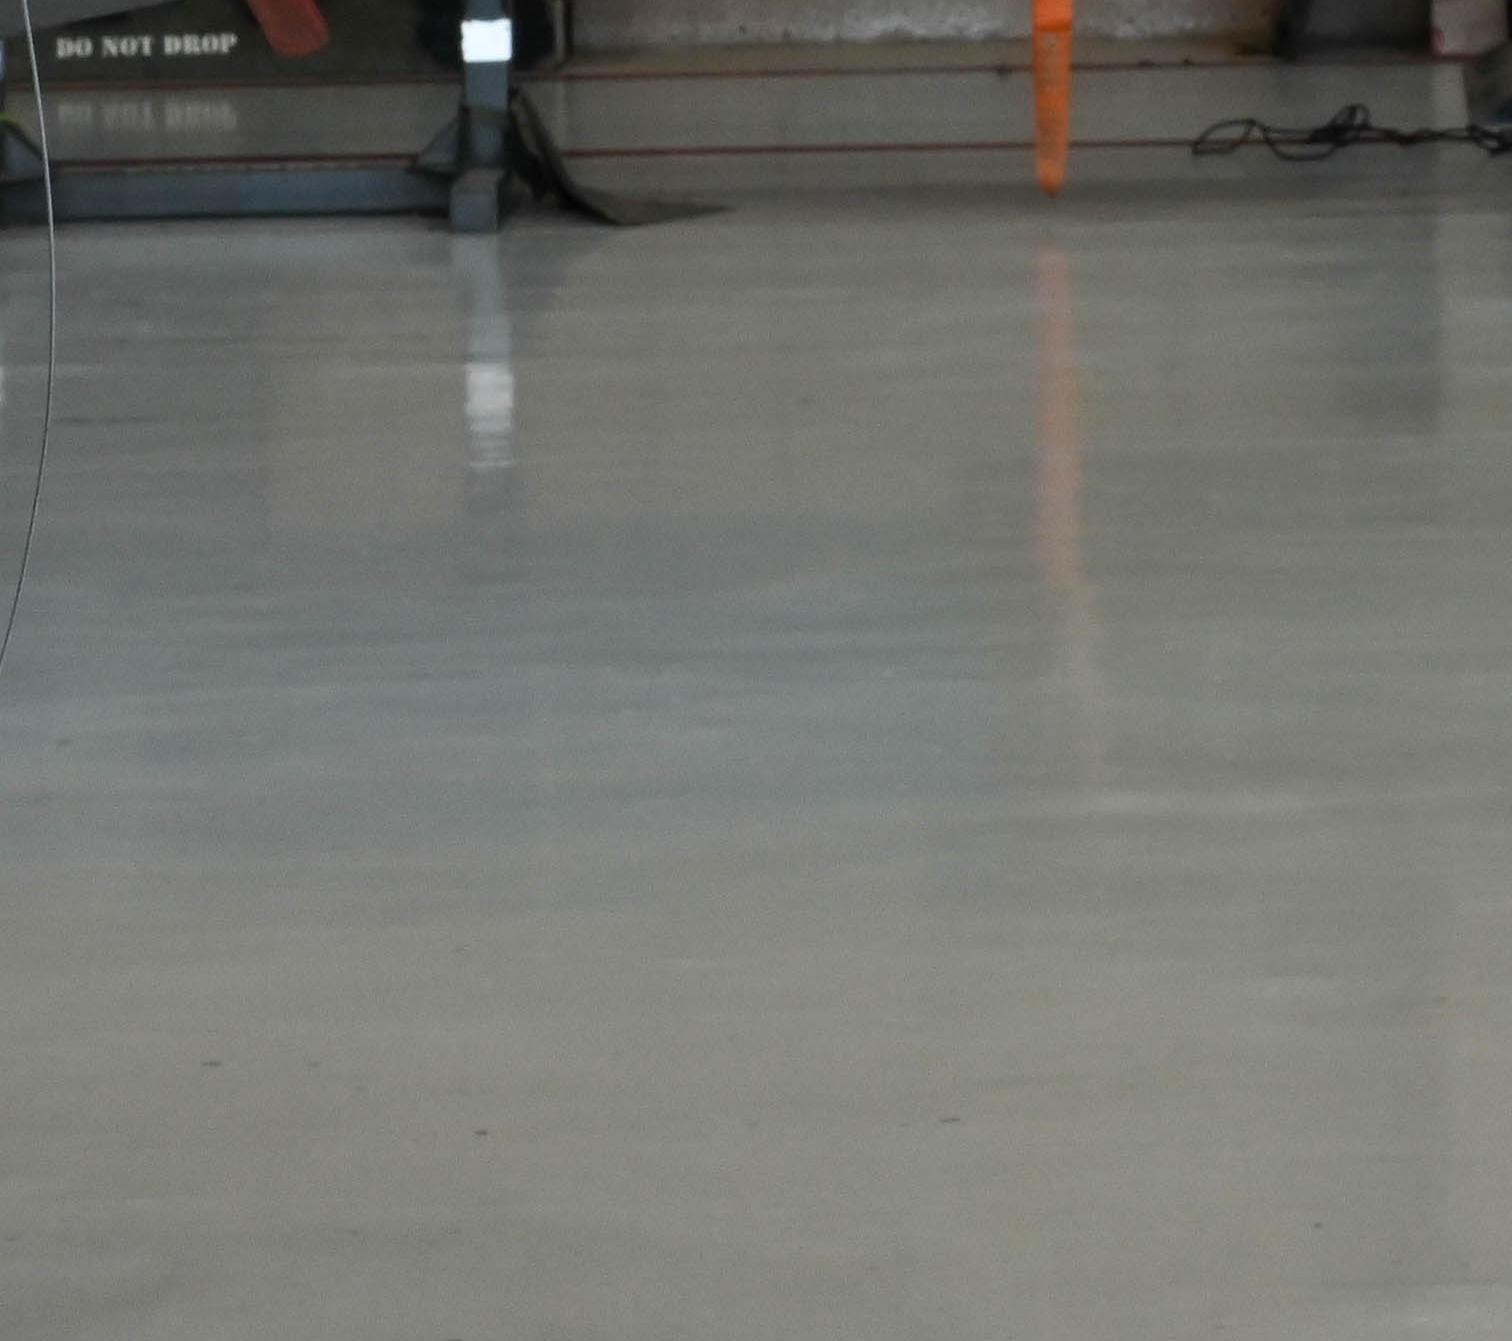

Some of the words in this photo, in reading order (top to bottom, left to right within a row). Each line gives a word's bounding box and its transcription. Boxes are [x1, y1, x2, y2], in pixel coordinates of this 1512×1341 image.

[56, 35, 94, 59] DO
[102, 34, 155, 57] NOT
[163, 31, 240, 56] DROP
